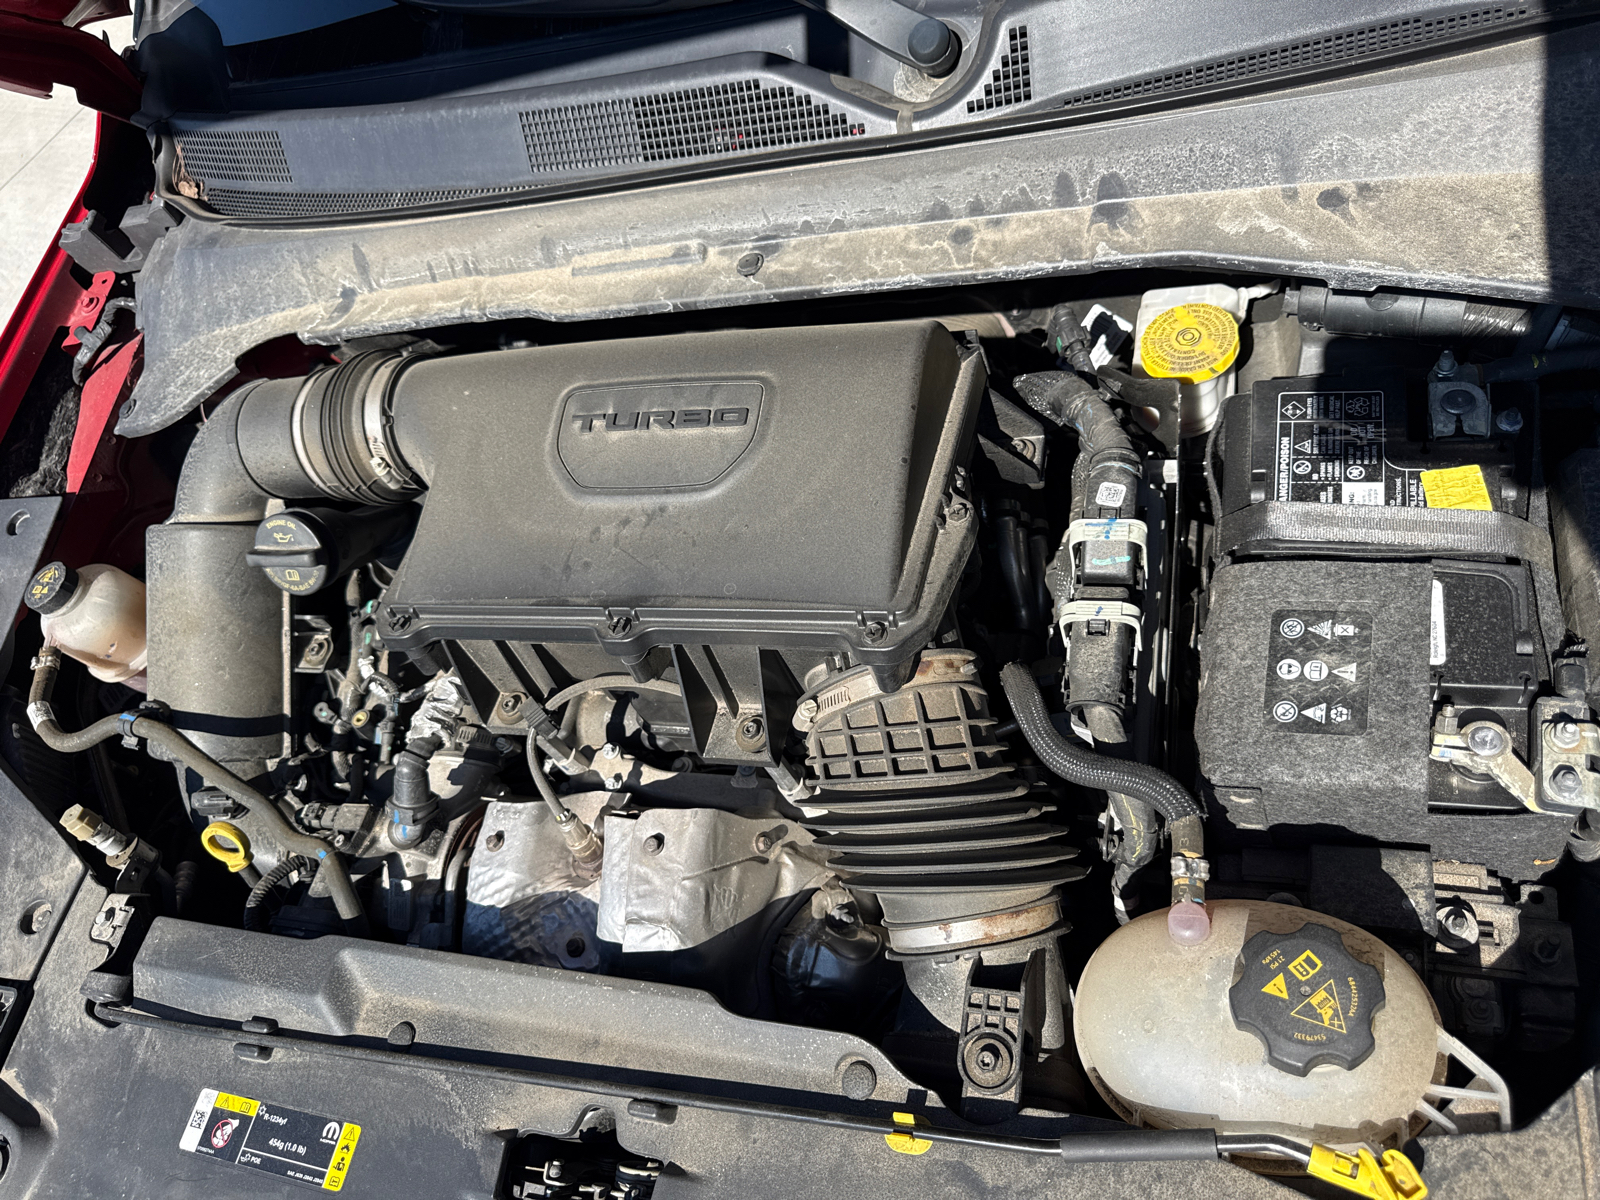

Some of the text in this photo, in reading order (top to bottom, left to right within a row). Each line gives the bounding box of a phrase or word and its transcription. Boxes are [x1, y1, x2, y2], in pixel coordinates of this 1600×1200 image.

[572, 408, 749, 434] TURBO
[1279, 437, 1290, 501] ANGER/POISON
[266, 520, 296, 530] ENGINE OIL
[1262, 949, 1281, 964] 145 kPa
[1270, 955, 1286, 970] 21 PSI
[263, 1114, 288, 1126] R-1234yf
[269, 1138, 306, 1156] 454g (1.0 lb)
